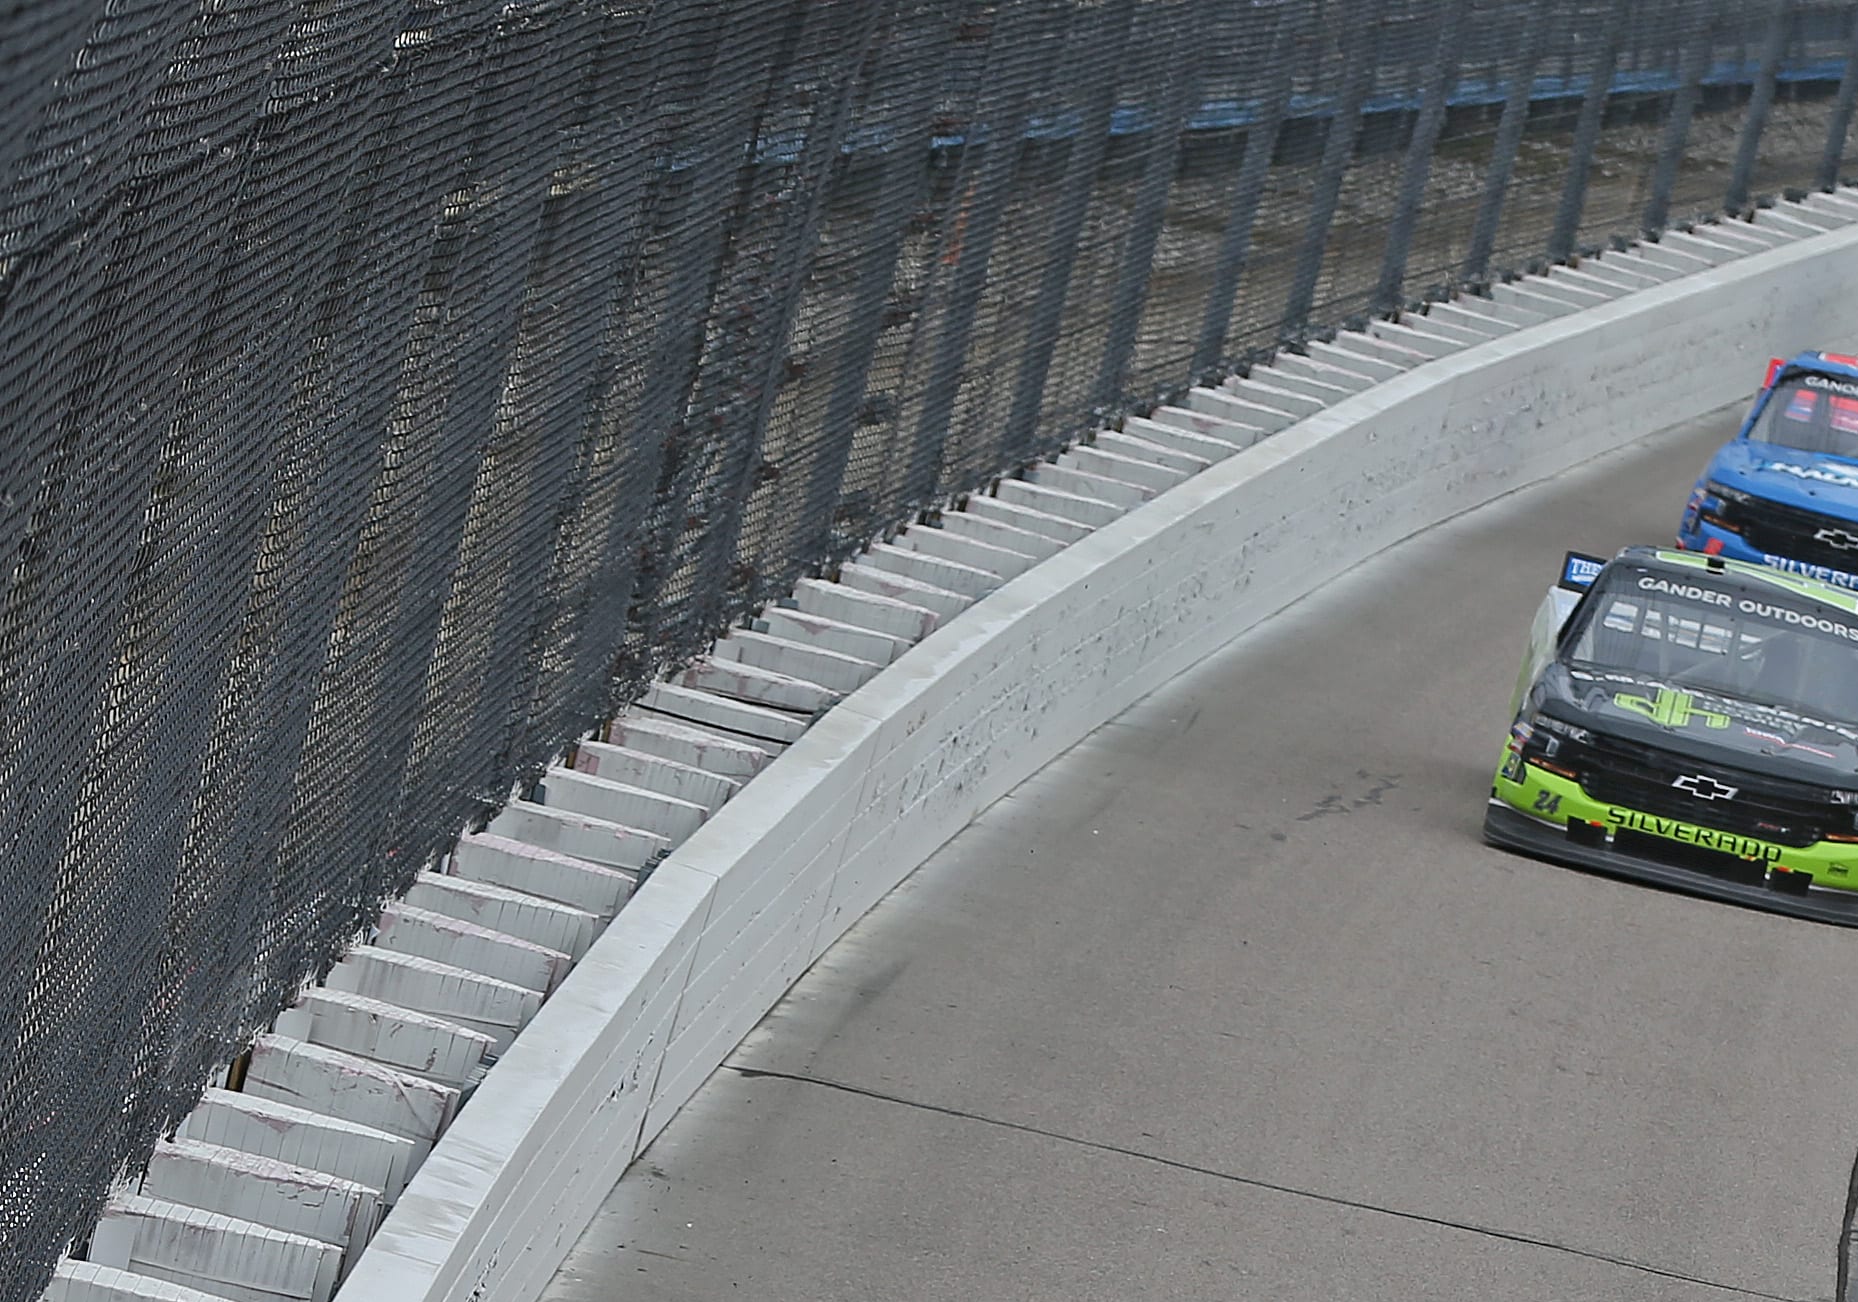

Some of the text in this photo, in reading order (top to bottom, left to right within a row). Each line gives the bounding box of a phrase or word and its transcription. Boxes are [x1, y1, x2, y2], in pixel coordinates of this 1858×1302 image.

[1637, 576, 1732, 609] GANDER
[1533, 789, 1563, 815] 24
[1606, 806, 1783, 863] SILVERADO
